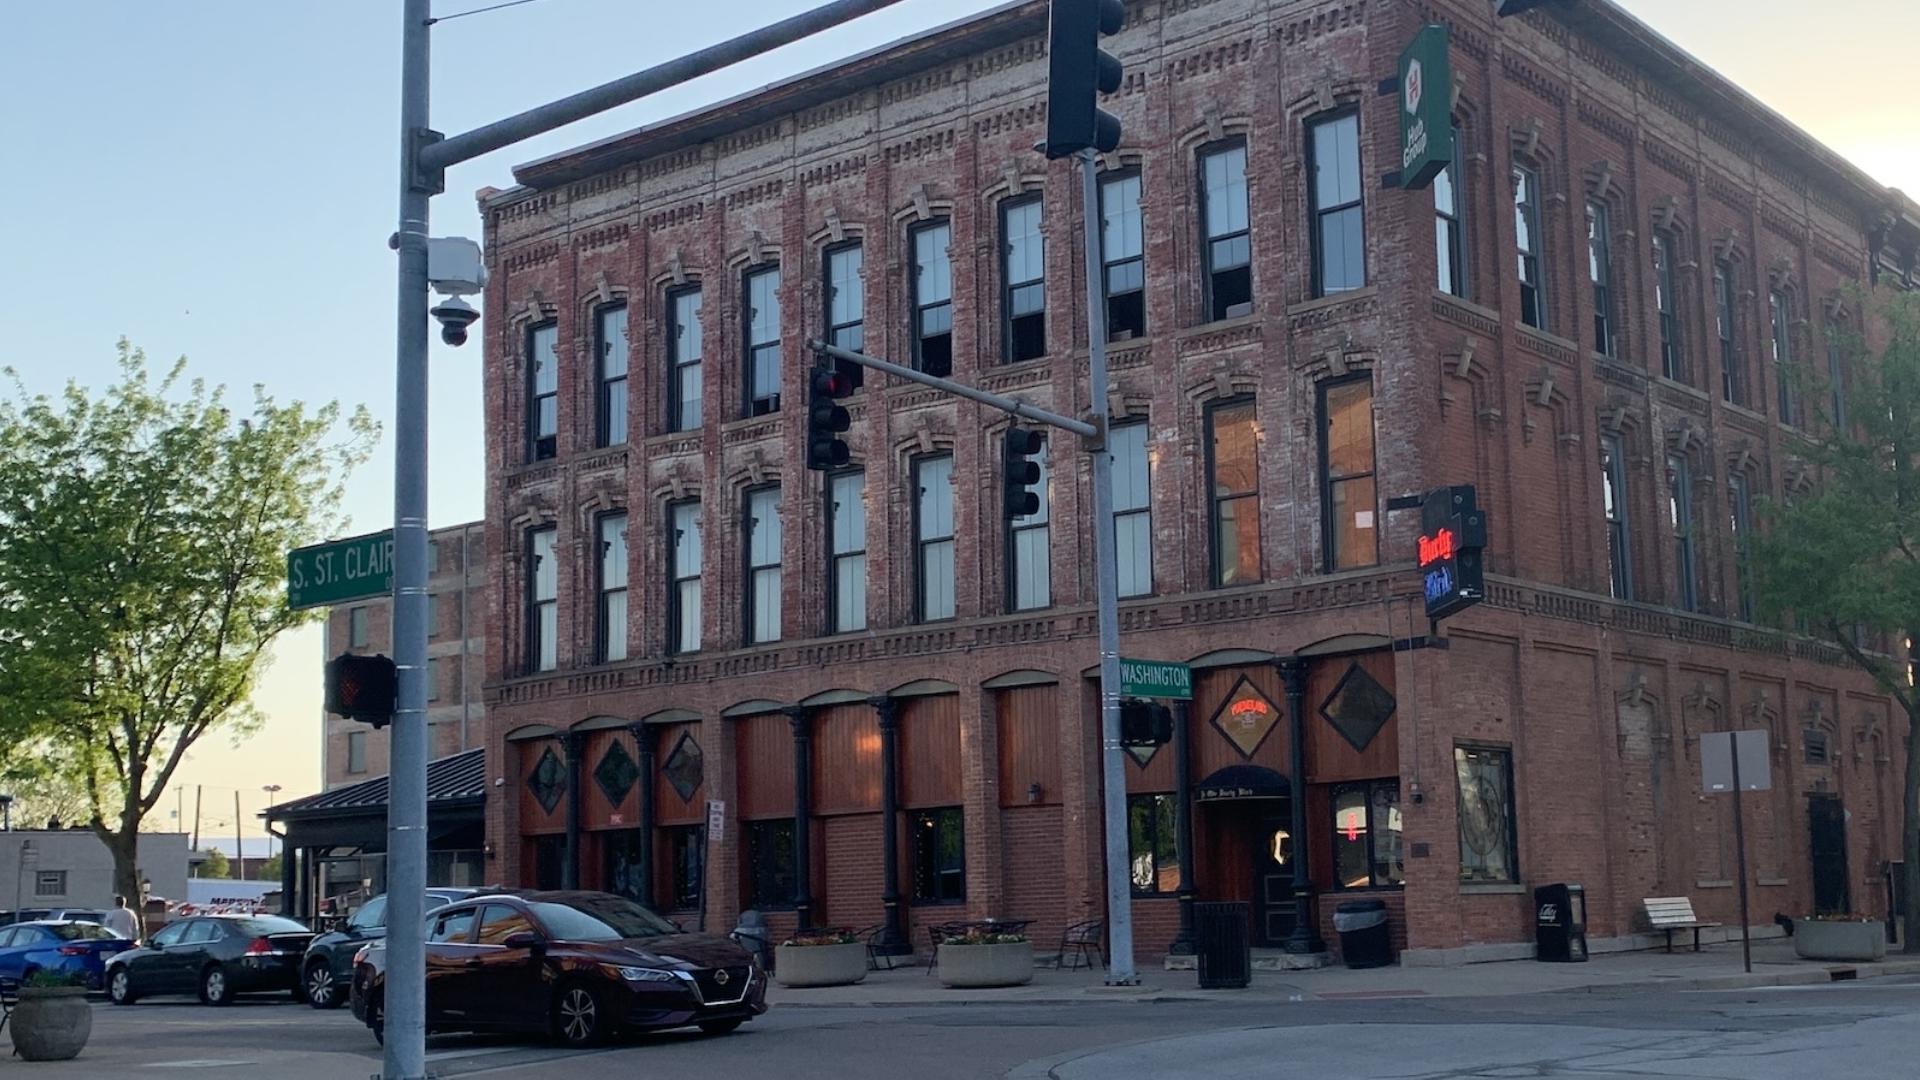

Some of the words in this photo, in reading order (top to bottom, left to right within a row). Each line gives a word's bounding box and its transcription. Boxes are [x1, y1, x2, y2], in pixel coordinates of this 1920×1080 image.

[1403, 131, 1428, 169] Group
[293, 558, 308, 589] S.
[315, 552, 339, 585] ST.
[345, 539, 394, 579] CLAIR
[1120, 663, 1189, 687] WASHINGTON
